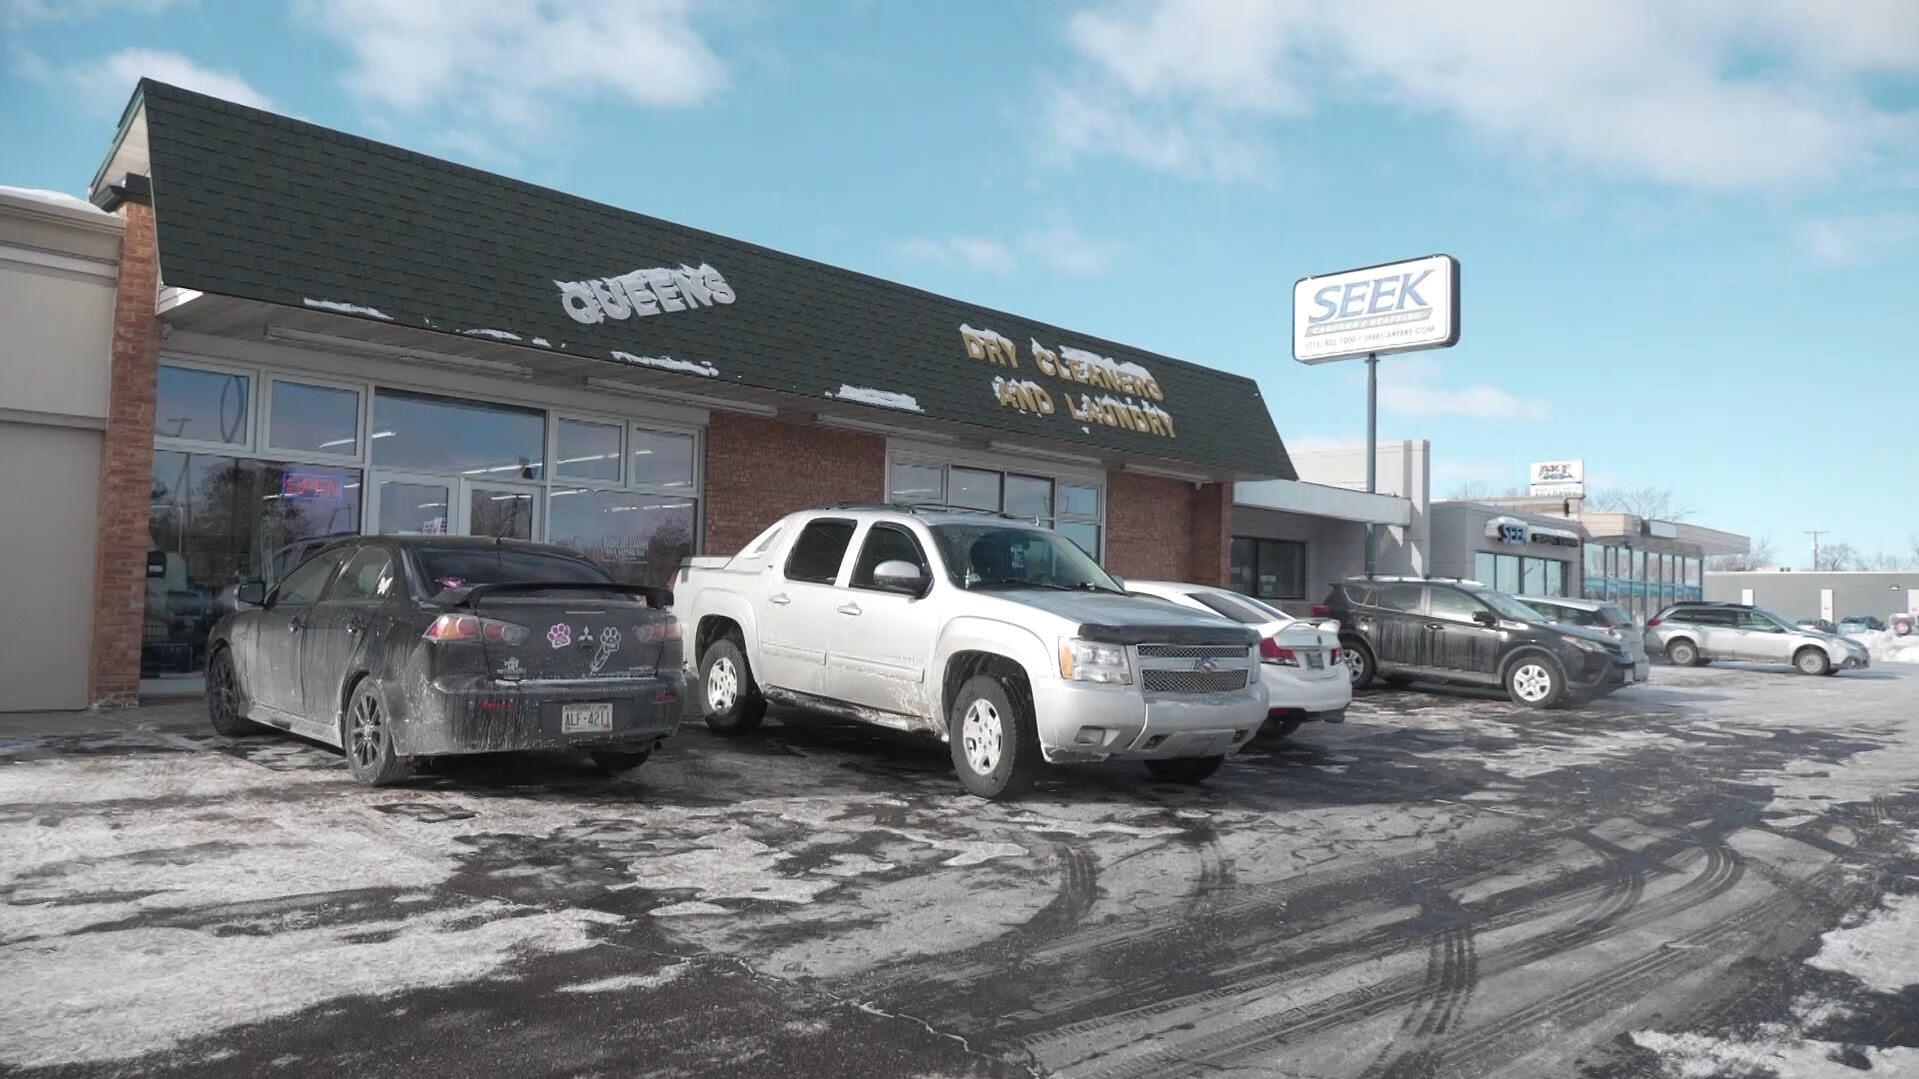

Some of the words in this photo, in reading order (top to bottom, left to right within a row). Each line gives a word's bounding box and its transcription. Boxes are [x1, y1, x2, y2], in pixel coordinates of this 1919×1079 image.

[559, 264, 737, 324] QUEENS
[1308, 269, 1436, 324] SEEK
[961, 328, 1018, 368] DRY
[1033, 346, 1163, 401] CLEANERS
[997, 377, 1054, 415] AND
[1064, 394, 1176, 438] LAUNDRY
[285, 477, 340, 497] OPEN
